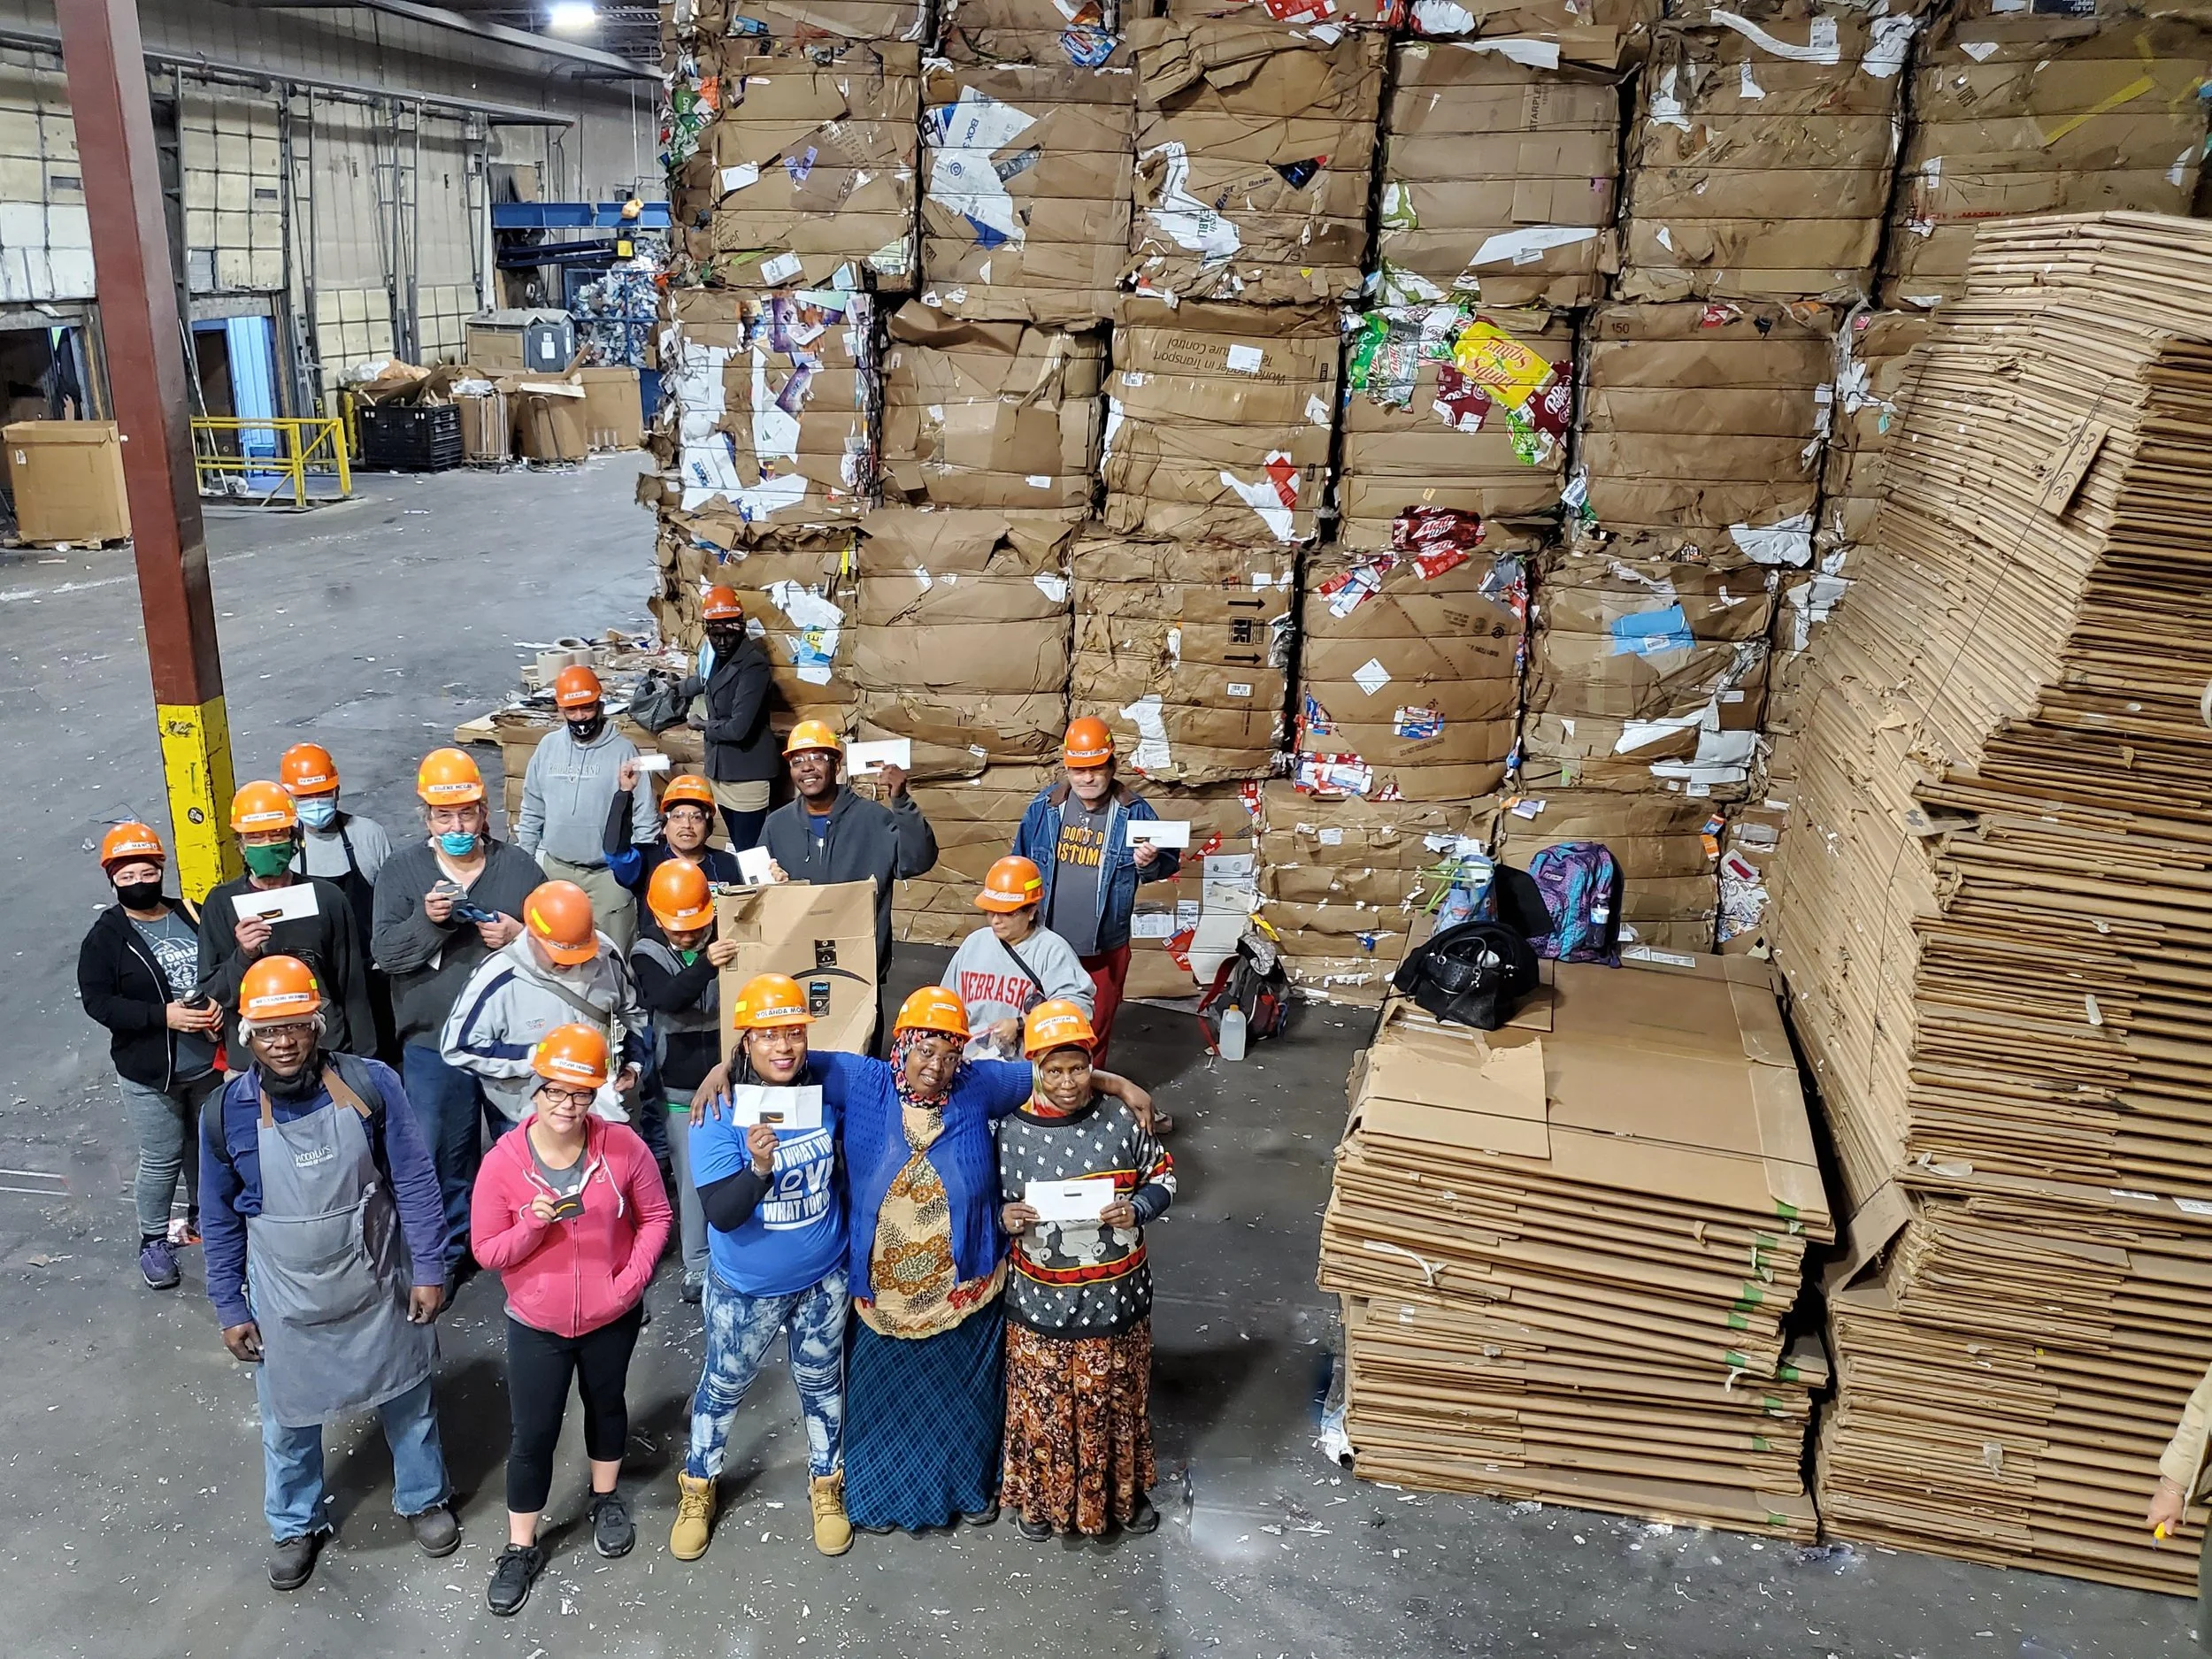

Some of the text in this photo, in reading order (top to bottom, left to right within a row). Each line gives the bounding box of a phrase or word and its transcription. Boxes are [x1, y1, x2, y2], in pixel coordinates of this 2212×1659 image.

[964, 118, 979, 142] BOX
[1610, 322, 1630, 334] 150
[1167, 337, 1206, 355] Control
[1482, 340, 1532, 370] Squirt
[1153, 350, 1201, 369] Transport
[1203, 360, 1214, 371] in
[1466, 357, 1518, 390] Squirt
[961, 970, 1033, 1011] NEBRASK
[757, 1008, 787, 1018] YOLANDA
[781, 1141, 817, 1168] WHAT
[763, 1200, 802, 1223] WHAT
[803, 1192, 823, 1217] YOU
